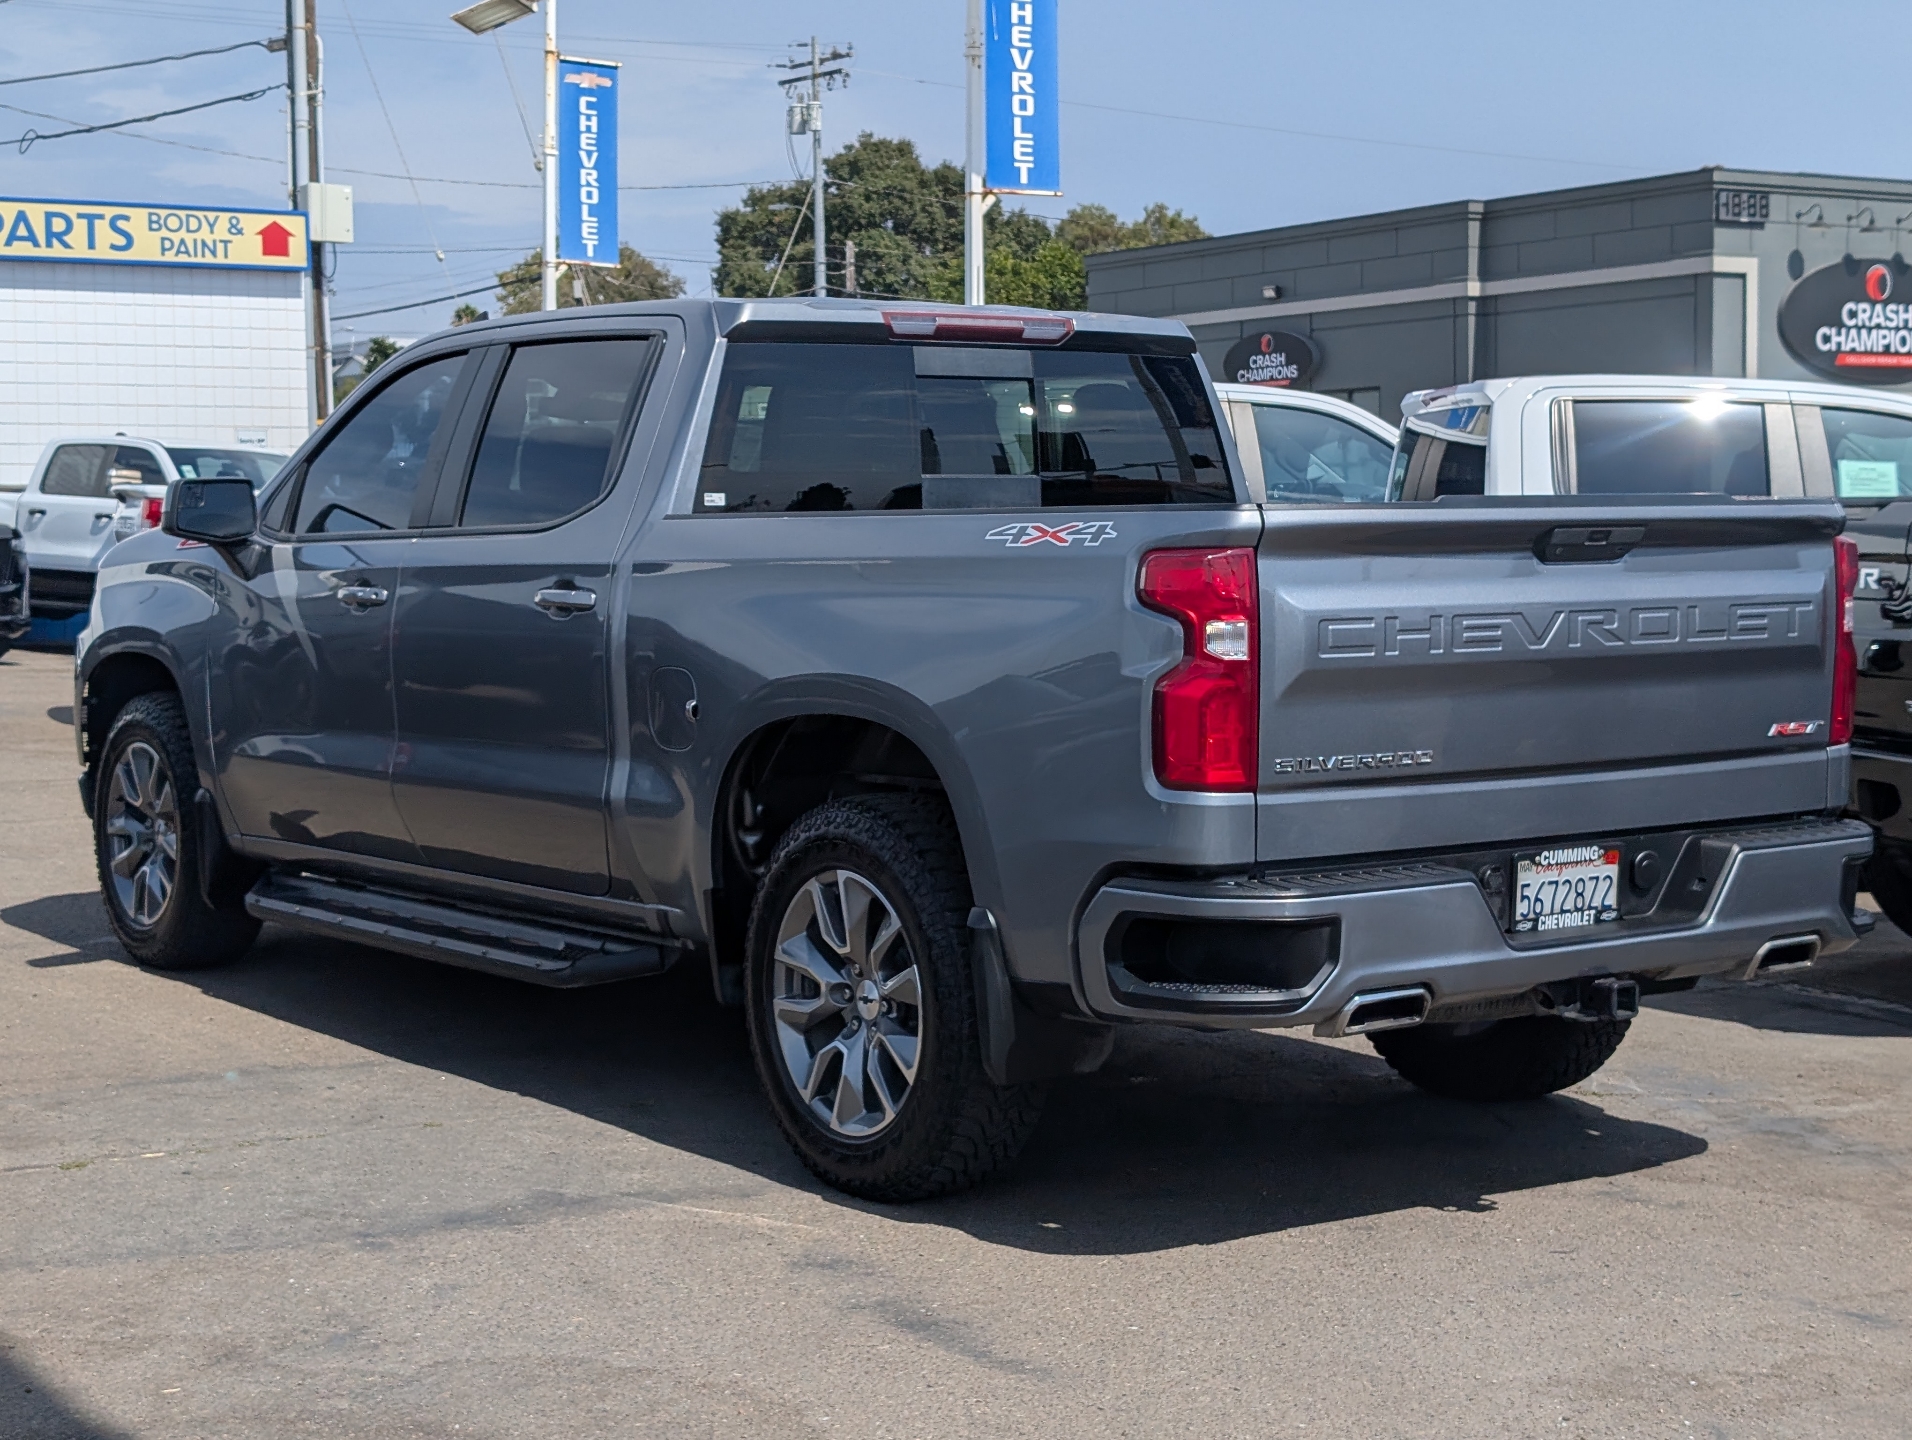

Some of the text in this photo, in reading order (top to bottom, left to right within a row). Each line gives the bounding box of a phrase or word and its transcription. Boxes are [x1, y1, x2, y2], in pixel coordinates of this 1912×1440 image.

[1010, 0, 1036, 184] HEVROLET
[578, 96, 600, 258] CHEVROLET
[0, 210, 135, 251] ARTS
[147, 211, 244, 236] BODY &
[160, 237, 233, 259] PAINT
[1841, 301, 1912, 329] CRASH
[1815, 326, 1912, 353] CHAMPIO
[1249, 352, 1287, 369] CRASH
[1237, 365, 1299, 383] CHAMPIONS
[1318, 600, 1814, 658] CHEVROLET
[1767, 720, 1825, 737] RST
[1274, 750, 1433, 773] SILVERADO
[1540, 846, 1600, 866] CUMMING
[1537, 909, 1596, 931] CHEVROLET
